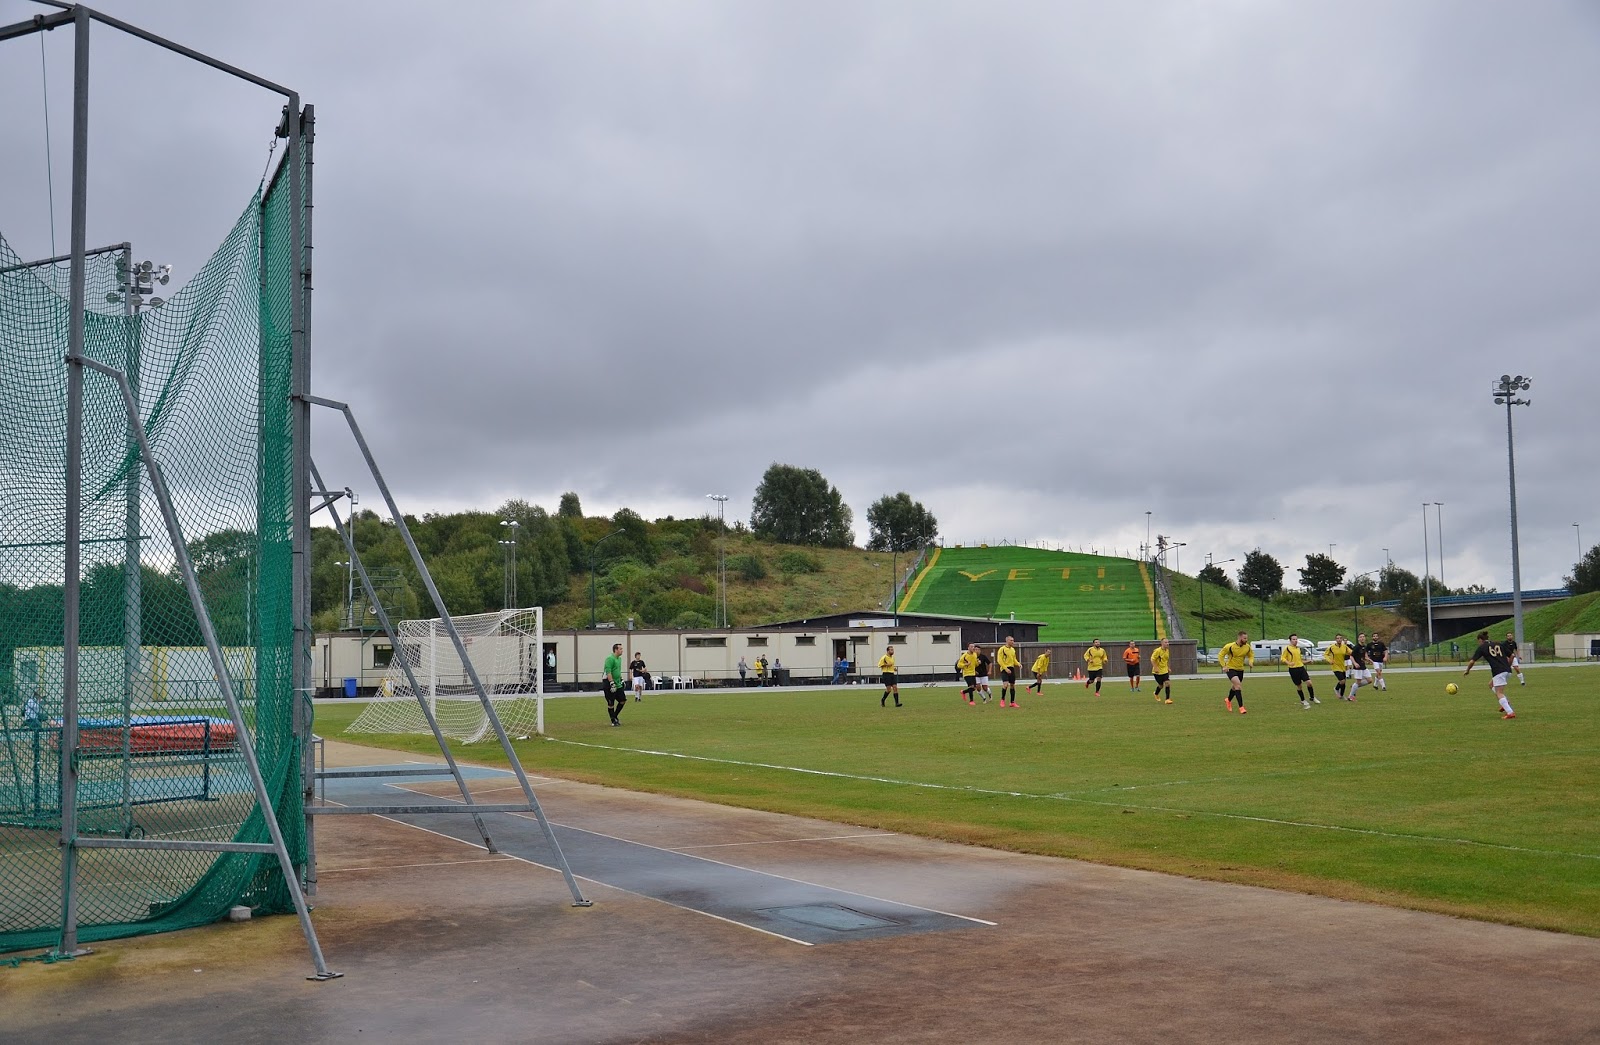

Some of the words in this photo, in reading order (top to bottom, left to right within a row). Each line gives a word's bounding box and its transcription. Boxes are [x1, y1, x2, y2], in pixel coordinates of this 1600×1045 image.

[957, 567, 1106, 582] YETI
[1078, 584, 1126, 592] SKI
[1488, 645, 1503, 657] 69
